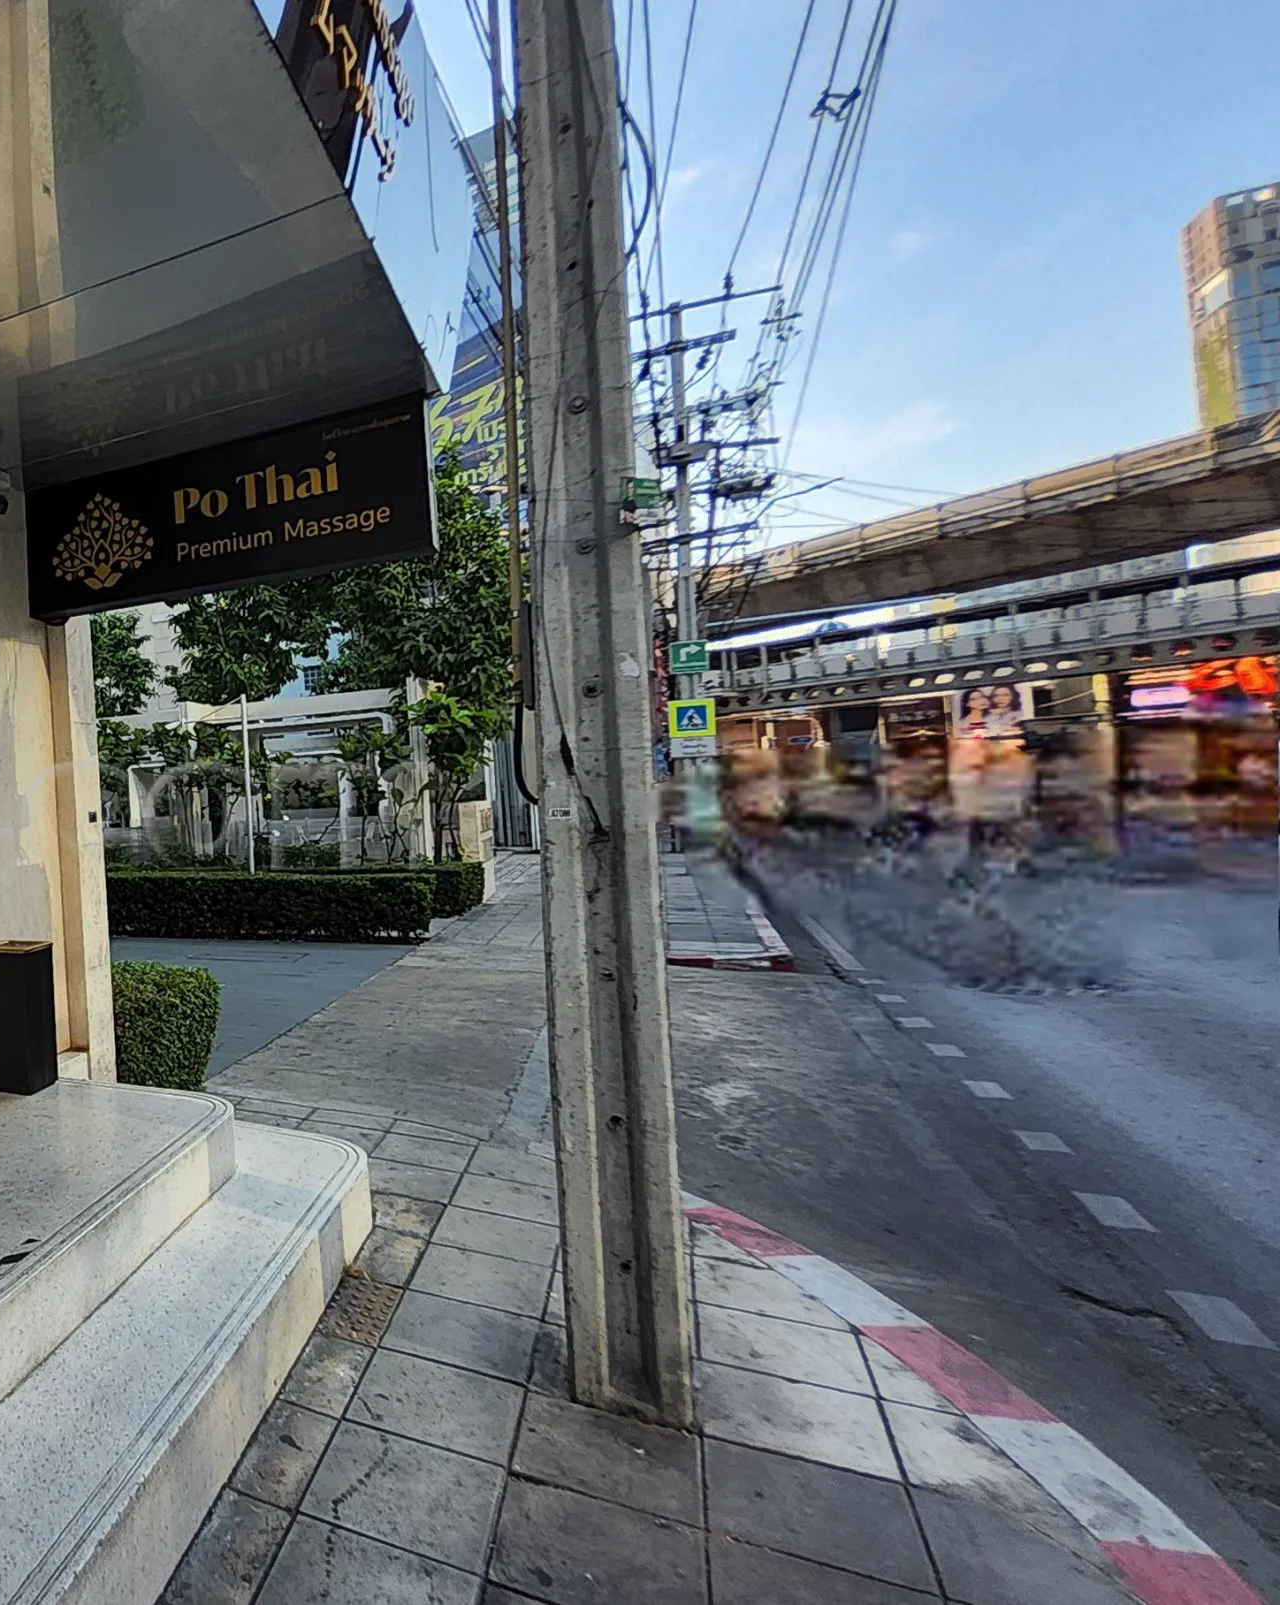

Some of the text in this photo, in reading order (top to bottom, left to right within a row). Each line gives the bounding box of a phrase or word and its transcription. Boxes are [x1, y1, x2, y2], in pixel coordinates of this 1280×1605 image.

[173, 450, 339, 525] Po Thai
[177, 506, 391, 562] Premium Massage
